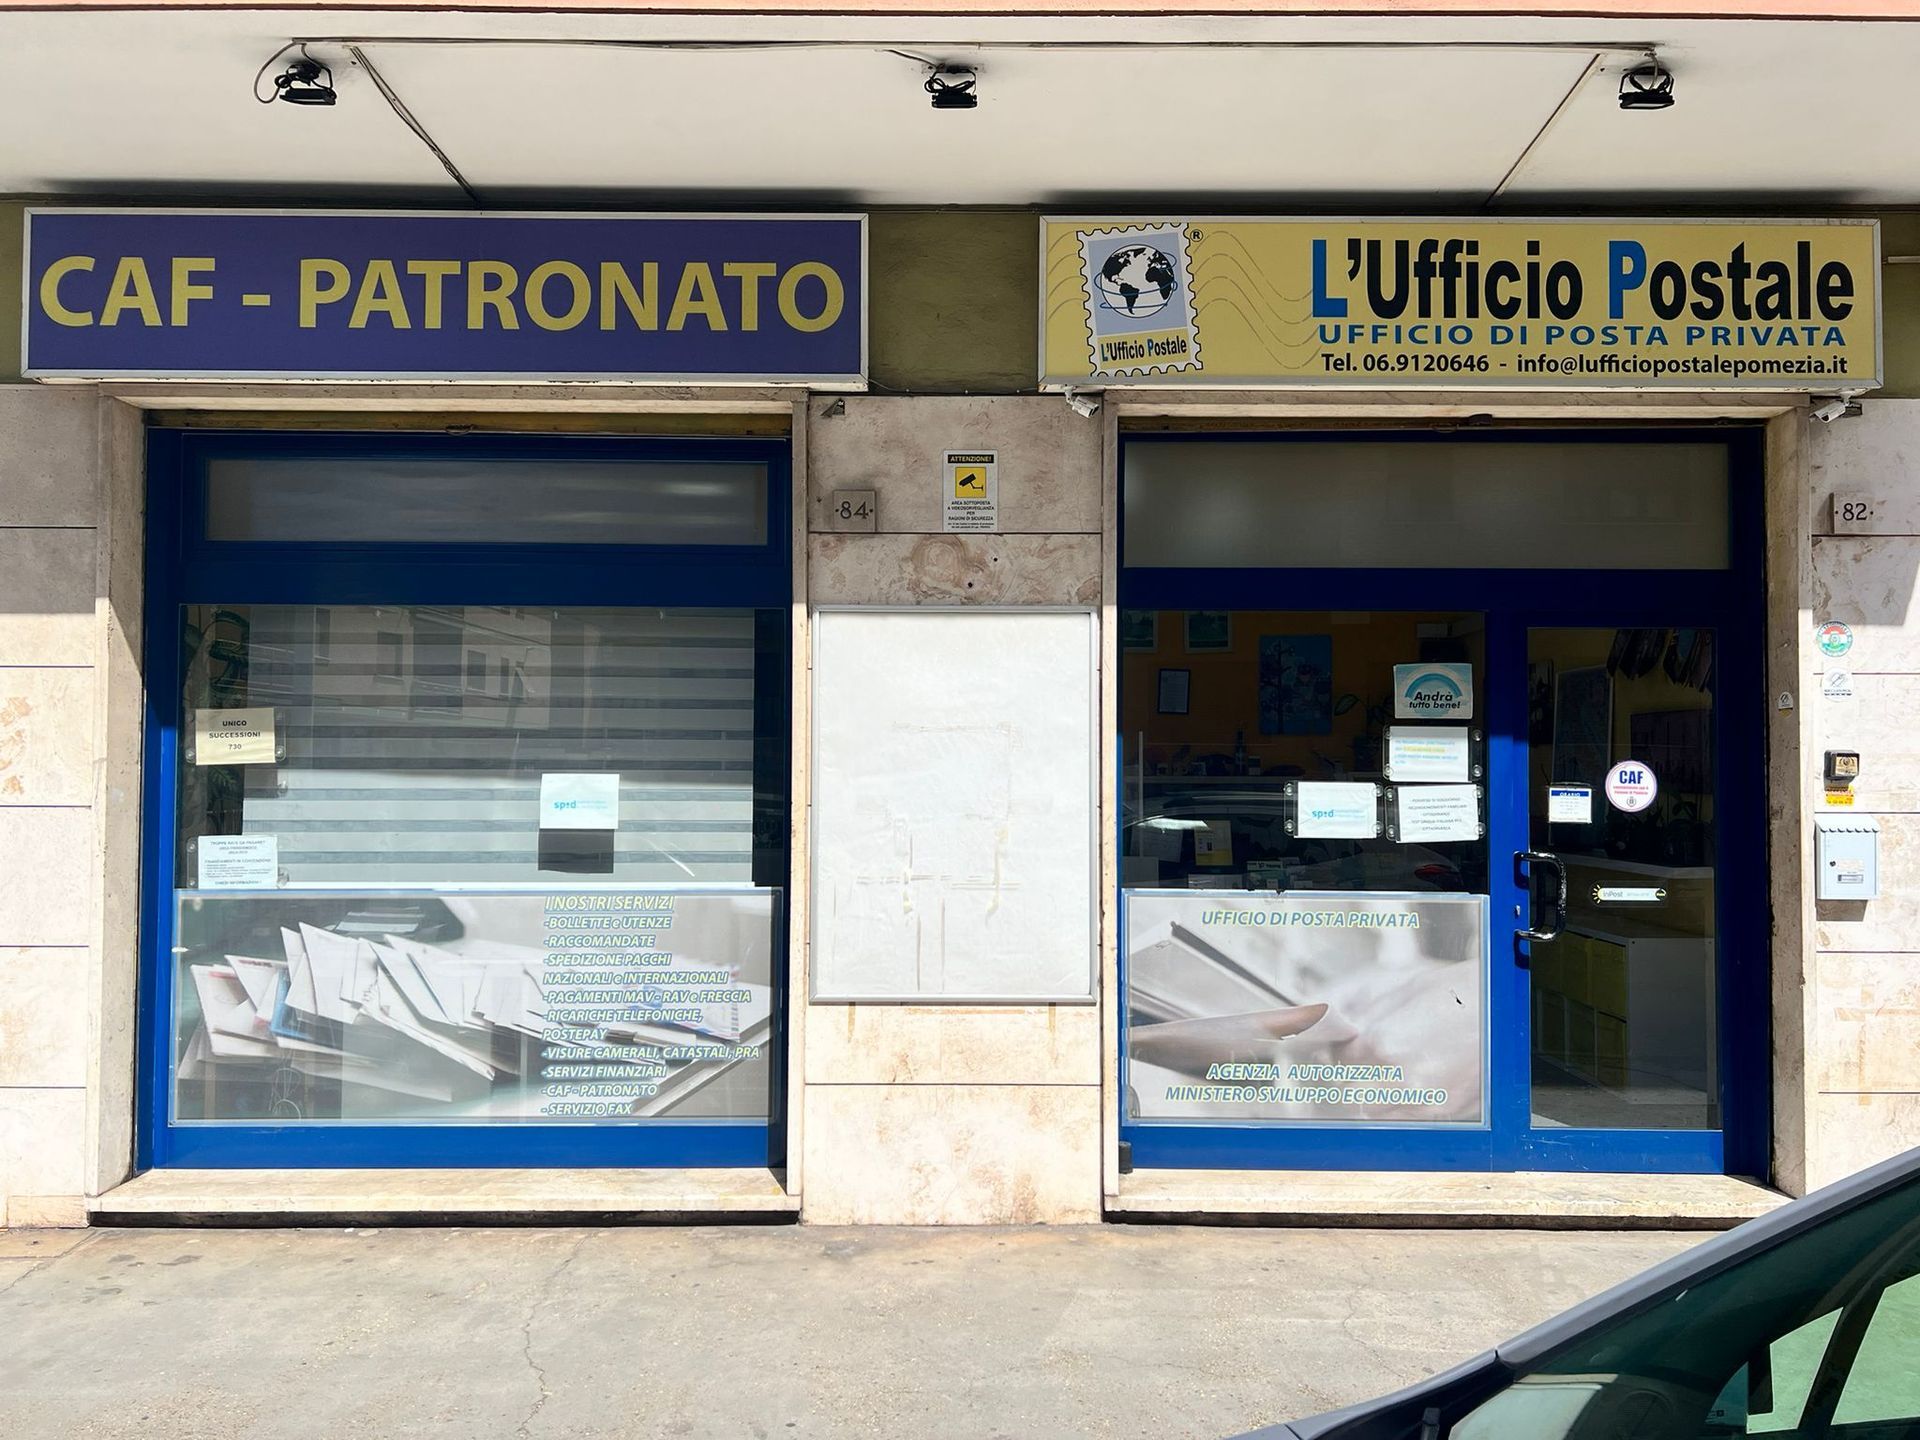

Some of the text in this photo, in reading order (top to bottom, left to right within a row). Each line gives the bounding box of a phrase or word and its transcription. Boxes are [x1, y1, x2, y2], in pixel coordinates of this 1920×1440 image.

[1312, 238, 1854, 321] L'Ufficio Postale
[40, 255, 845, 333] CAF - PATRONATO
[1319, 324, 1846, 346] UFFICIO DI POSTA PRIVATA
[1101, 336, 1187, 362] L'Ufficio Postale
[1321, 353, 1357, 371] Tel.
[1363, 354, 1489, 372] 06.9120646
[1517, 353, 1847, 377] info@lufficiopostalepomezia.it
[1842, 502, 1868, 521] 82
[1414, 691, 1453, 701] Andrà
[1409, 701, 1461, 709] tutto bene!
[222, 719, 247, 727] UNICO
[209, 731, 261, 739] SUCCESSIONI
[1619, 770, 1644, 784] CAF
[554, 895, 612, 910] NOSTRI
[614, 895, 674, 910] SERVIZI
[622, 916, 672, 929] UTENZE
[1201, 911, 1420, 929] UFFICIO DI POSTA PRIVATA
[623, 953, 672, 966] PACCHI
[543, 971, 613, 985] NAZIONALI
[622, 971, 729, 984] INTERNAZIONALI
[662, 990, 688, 1003] RAV
[699, 989, 752, 1003] FRECCIA
[615, 1008, 704, 1023] TELEFONICHE,
[542, 1027, 608, 1041] POSTEPAY
[593, 1046, 660, 1060] CAMERALI,
[662, 1045, 734, 1060] CATASTALI,
[734, 1045, 760, 1059] PRA
[595, 1064, 667, 1078] FINANZIARI
[1206, 1063, 1404, 1082] AGENZIA AUTORIZZATA
[580, 1083, 658, 1097] PATRONATO
[1164, 1086, 1448, 1106] MINISTERO SVILUPPO ECONOMICO
[548, 1102, 607, 1116] SERVIZIO
[607, 1101, 634, 1115] FAX
